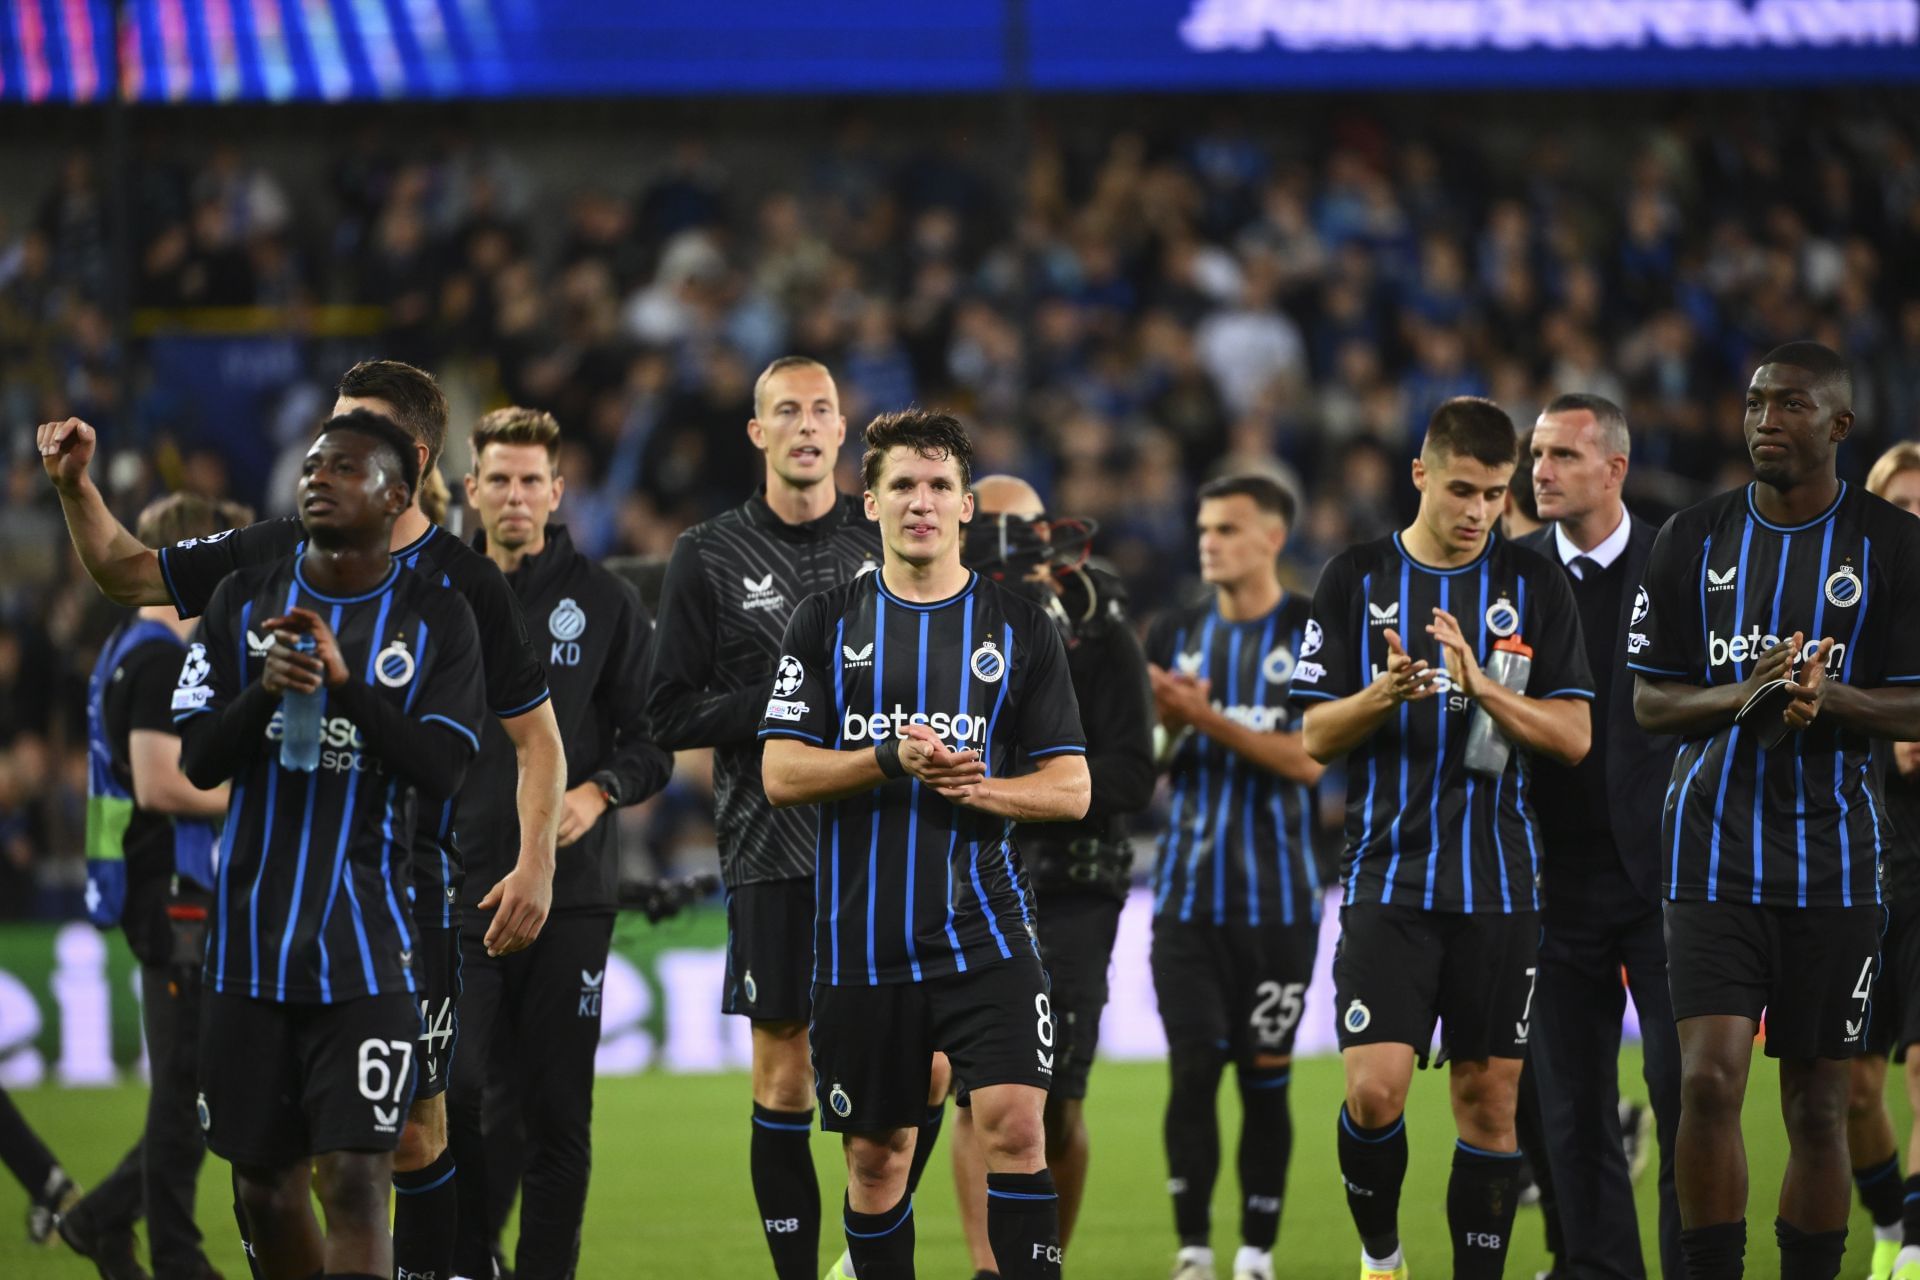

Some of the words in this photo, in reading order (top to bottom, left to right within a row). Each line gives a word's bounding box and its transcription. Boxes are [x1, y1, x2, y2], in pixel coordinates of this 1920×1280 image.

[550, 642, 581, 666] KD
[786, 705, 801, 716] 10
[1249, 980, 1305, 1030] 25
[1522, 967, 1537, 1020] 7
[1851, 956, 1873, 1012] 4
[1034, 992, 1054, 1048] 8
[358, 1037, 413, 1103] 67
[765, 1217, 799, 1233] FCB
[1466, 1232, 1501, 1249] FCB
